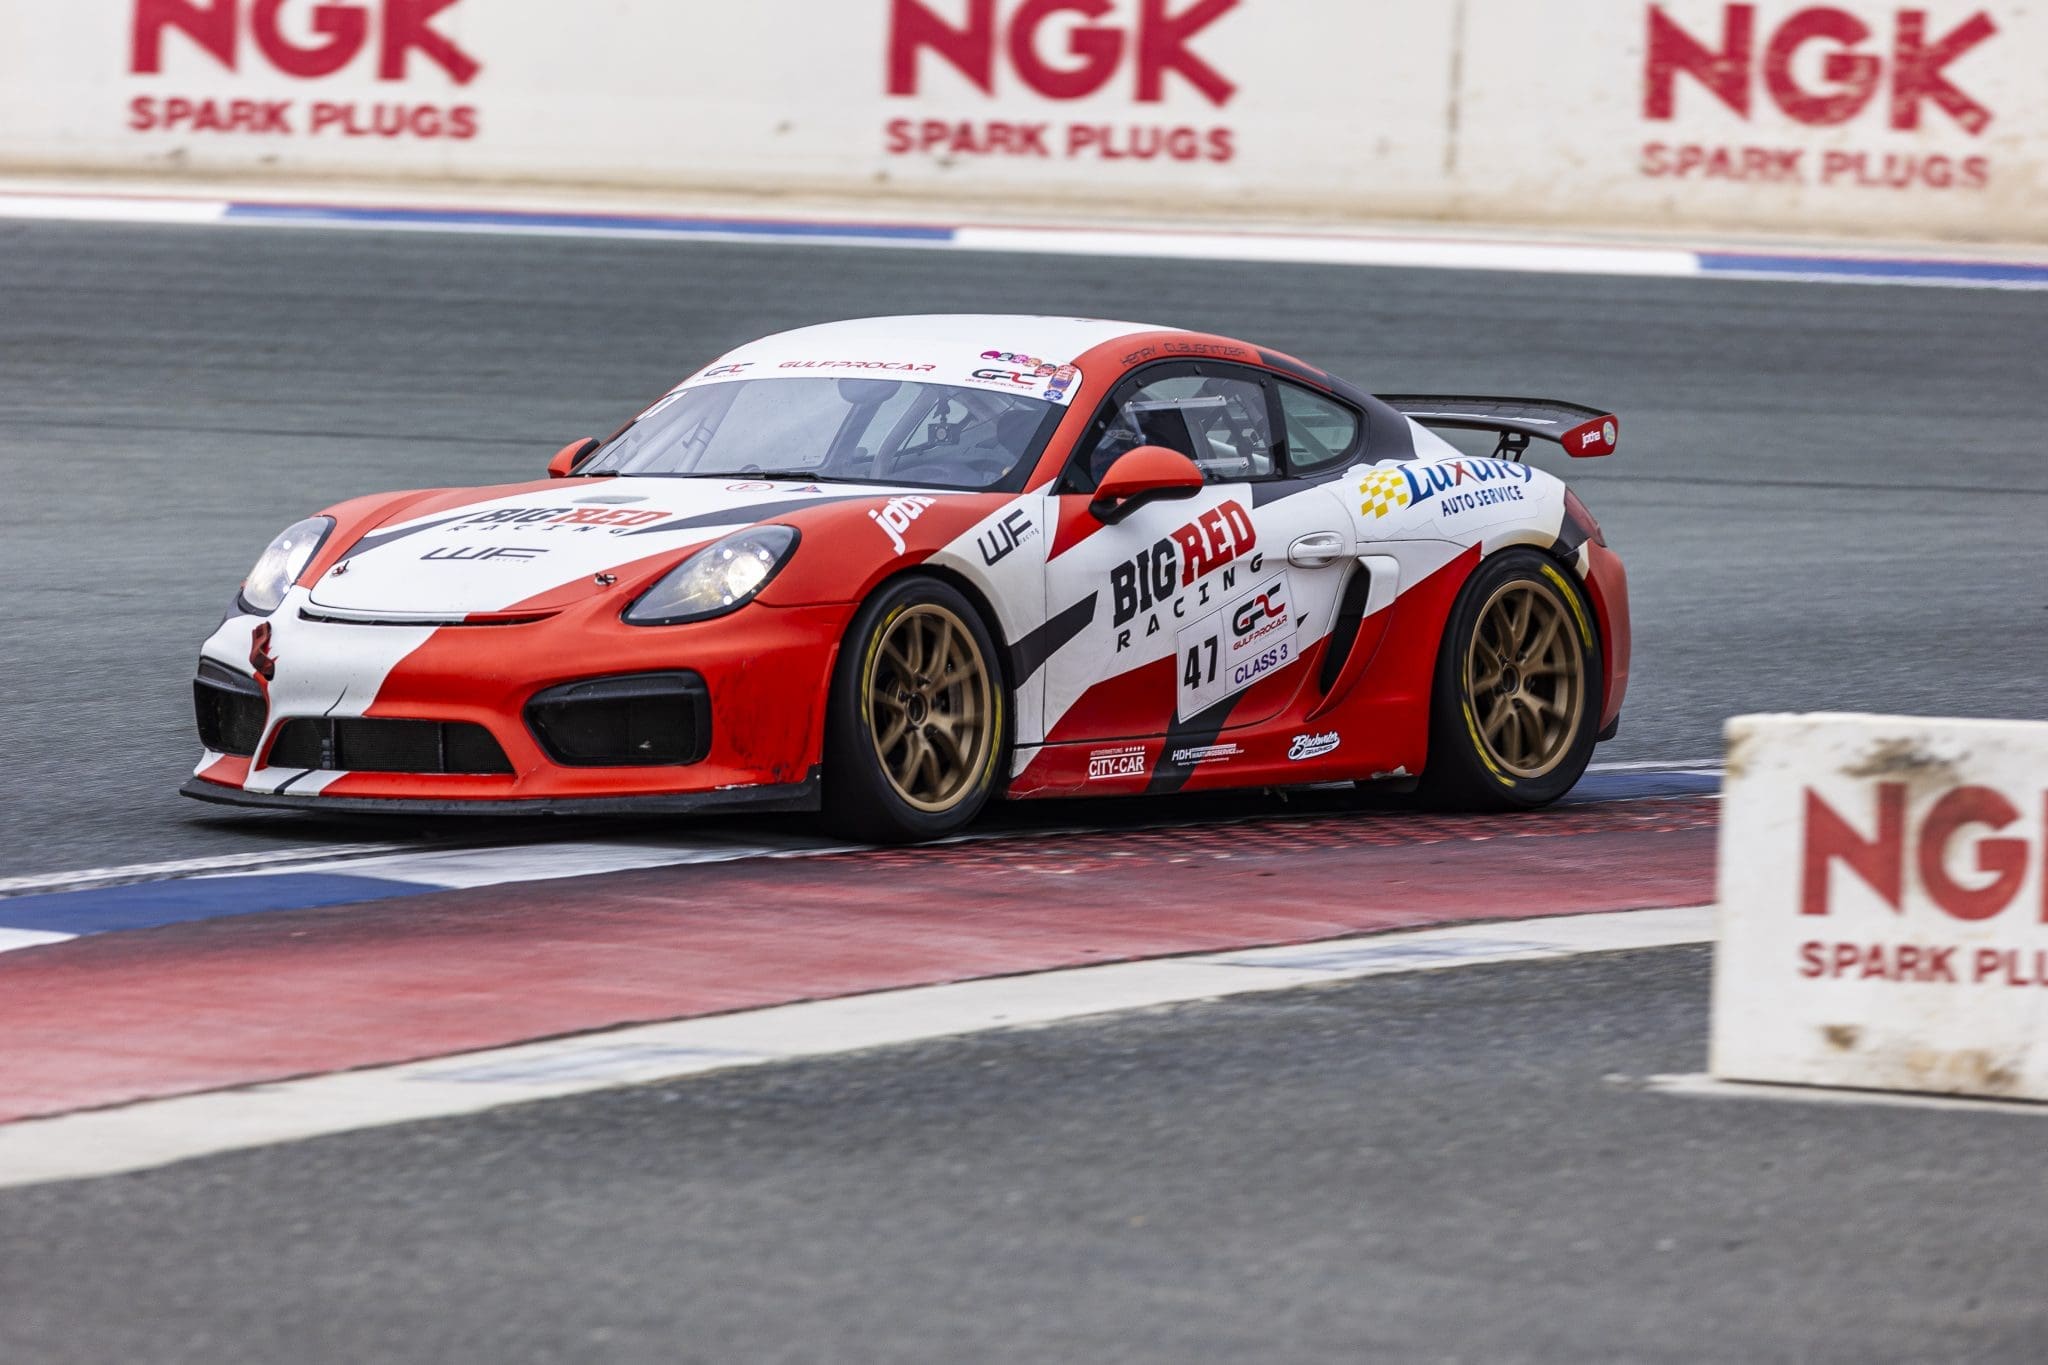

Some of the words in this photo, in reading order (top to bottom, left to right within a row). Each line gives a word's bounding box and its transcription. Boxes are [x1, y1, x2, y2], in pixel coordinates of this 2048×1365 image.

[129, 0, 483, 84] NGK
[886, 0, 1245, 106] NGK
[1643, 3, 1999, 136] NGK
[129, 97, 293, 134] SPARK
[309, 102, 478, 139] PLUGS
[886, 119, 1048, 156] SPARK
[1066, 124, 1234, 162] PLUGS
[1641, 143, 1804, 183] SPARK
[1821, 151, 1989, 189] PLUGS
[779, 361, 936, 371] GULFPROCAR
[1441, 493, 1475, 517] AUTO
[1475, 485, 1524, 506] SERVICE
[448, 524, 628, 534] RACING
[1116, 552, 1263, 653] RACING
[1233, 615, 1287, 650] GULFPROCAR
[1184, 635, 1218, 690] 47
[1235, 649, 1277, 684] CLASS
[1280, 643, 1288, 660] 3
[1089, 756, 1144, 776] CITY-CAR
[1799, 781, 2048, 924] NG
[1798, 941, 1957, 982] SPARK
